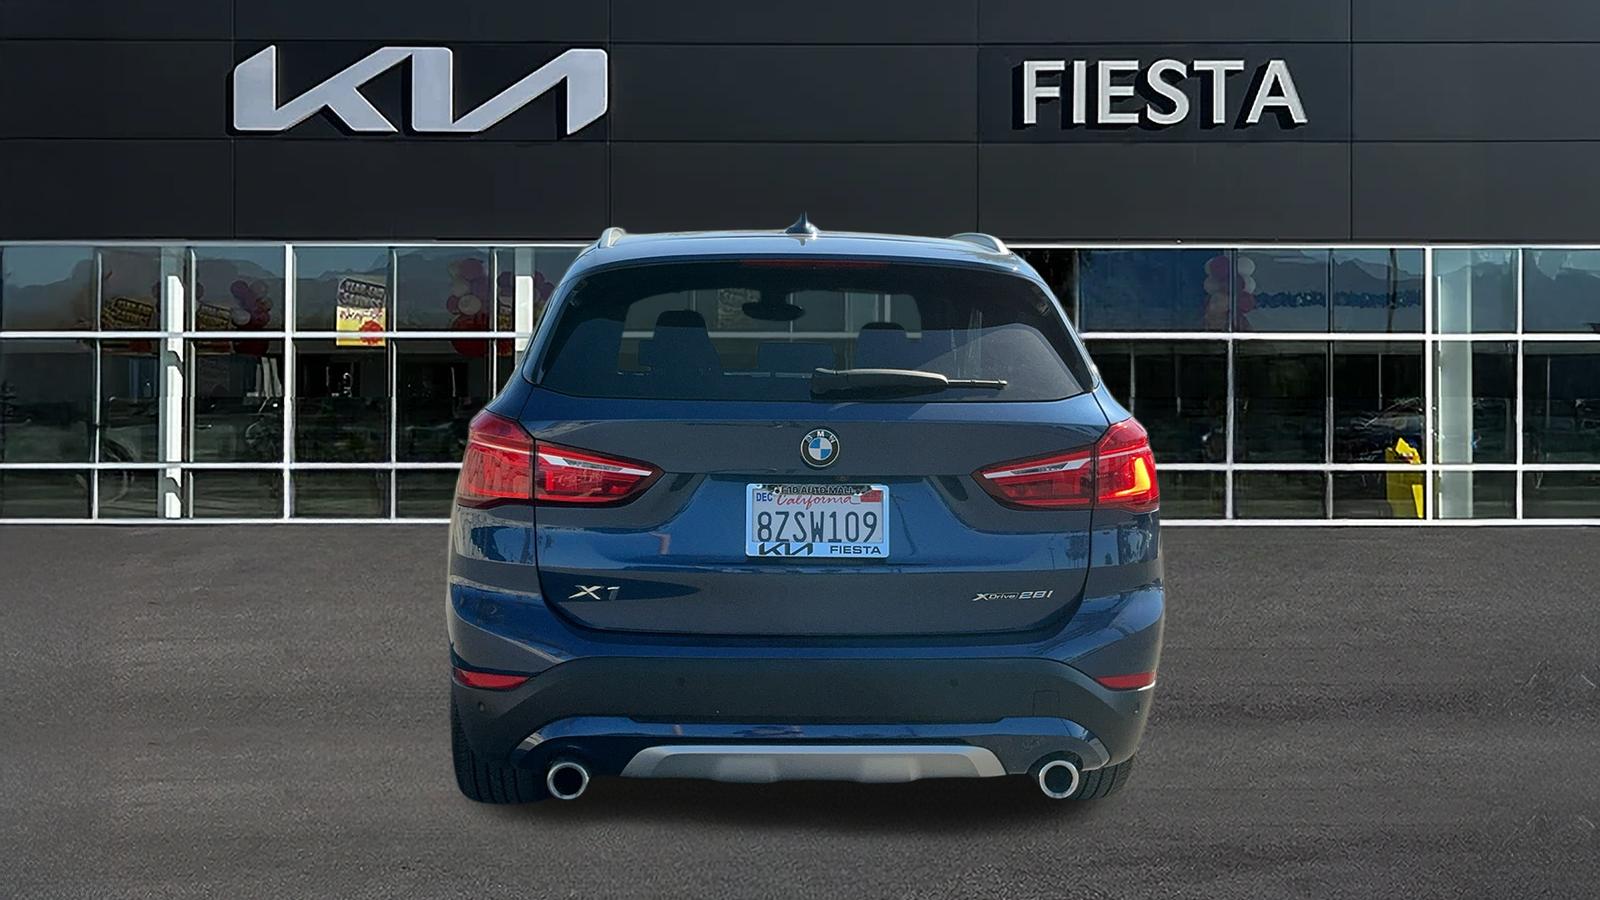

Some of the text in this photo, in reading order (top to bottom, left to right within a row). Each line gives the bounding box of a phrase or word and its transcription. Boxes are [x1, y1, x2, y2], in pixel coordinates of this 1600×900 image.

[1022, 59, 1308, 125] FIESTA
[756, 492, 773, 502] DEC
[777, 495, 861, 510] California
[757, 511, 878, 543] 8ZSW109
[830, 545, 881, 555] FIESTA
[568, 585, 620, 600] X1
